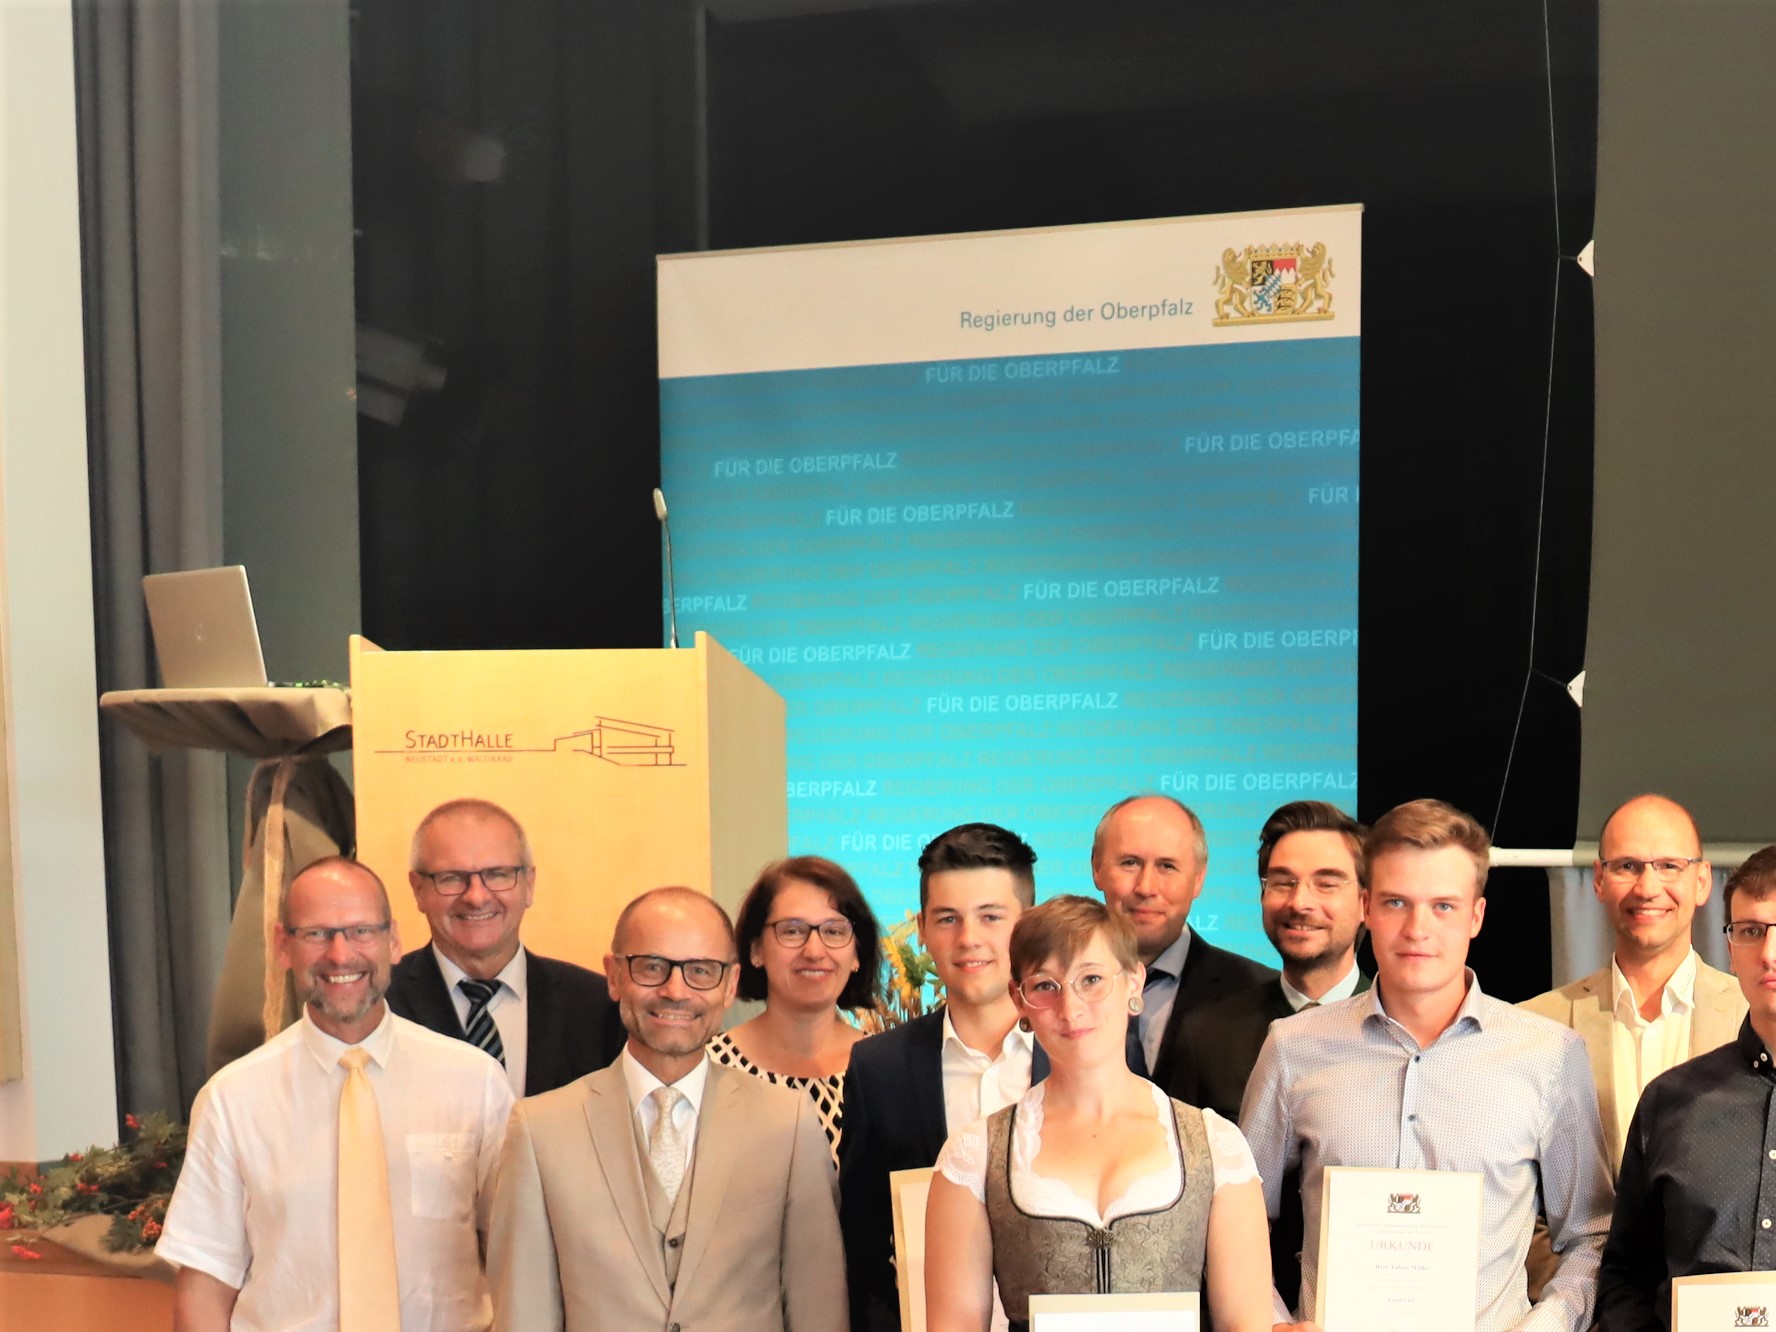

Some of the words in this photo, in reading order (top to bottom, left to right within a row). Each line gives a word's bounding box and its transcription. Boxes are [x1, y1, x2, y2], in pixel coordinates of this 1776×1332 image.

[959, 306, 1057, 331] Regierung
[1063, 304, 1095, 323] der
[1100, 298, 1194, 326] Oberpfalz
[925, 363, 963, 383] FÜR
[968, 362, 999, 381] DIE
[1004, 357, 1119, 380] OBERPFALZ
[1185, 431, 1224, 453] FÜR
[1231, 433, 1261, 450] DIE
[715, 458, 751, 478] FÜR
[756, 457, 785, 475] DIE
[789, 452, 897, 474] OBERPFALZ
[1308, 485, 1349, 504] FÜR
[826, 505, 862, 525] FÜR
[868, 505, 898, 524] DIE
[903, 501, 1014, 522] OBERPFALZ
[1023, 581, 1062, 600] FÜR
[1067, 581, 1098, 598] DIE
[1104, 577, 1220, 597] OBERPFALZ
[1198, 630, 1237, 650] FÜR
[1244, 632, 1274, 648] DIE
[769, 647, 797, 663] DIE
[804, 643, 912, 662] OBERPFALZ
[927, 693, 964, 713] FÜR
[970, 695, 1000, 712] DIE
[1005, 692, 1119, 711] OBERPFALZ
[1160, 771, 1199, 791] FÜR
[1206, 774, 1236, 790] DIE
[841, 832, 877, 851] FÜR
[883, 834, 911, 850] DIE
